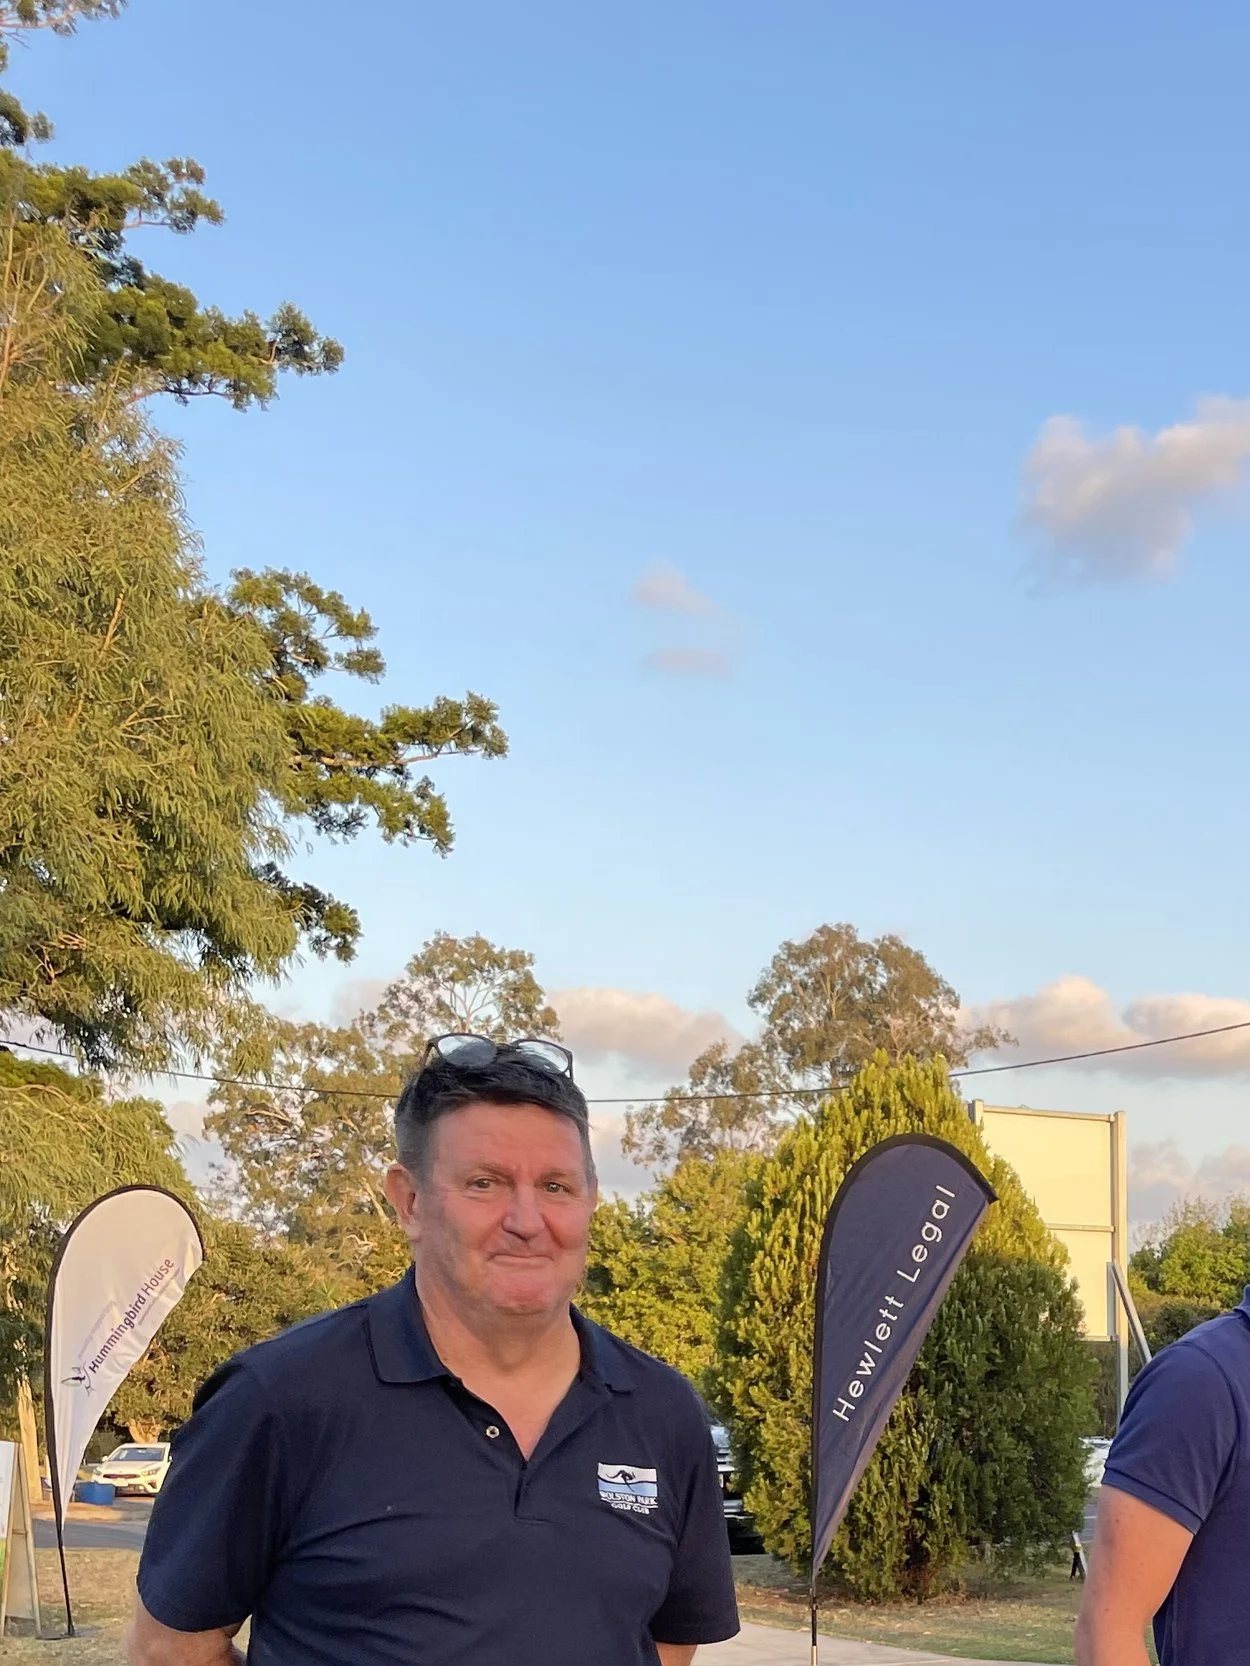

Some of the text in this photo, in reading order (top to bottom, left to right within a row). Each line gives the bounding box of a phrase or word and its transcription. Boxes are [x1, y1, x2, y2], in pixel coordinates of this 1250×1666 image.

[88, 1293, 147, 1374] Hummingbird
[140, 1258, 175, 1297] House
[832, 1184, 956, 1422] Hewlett Legal
